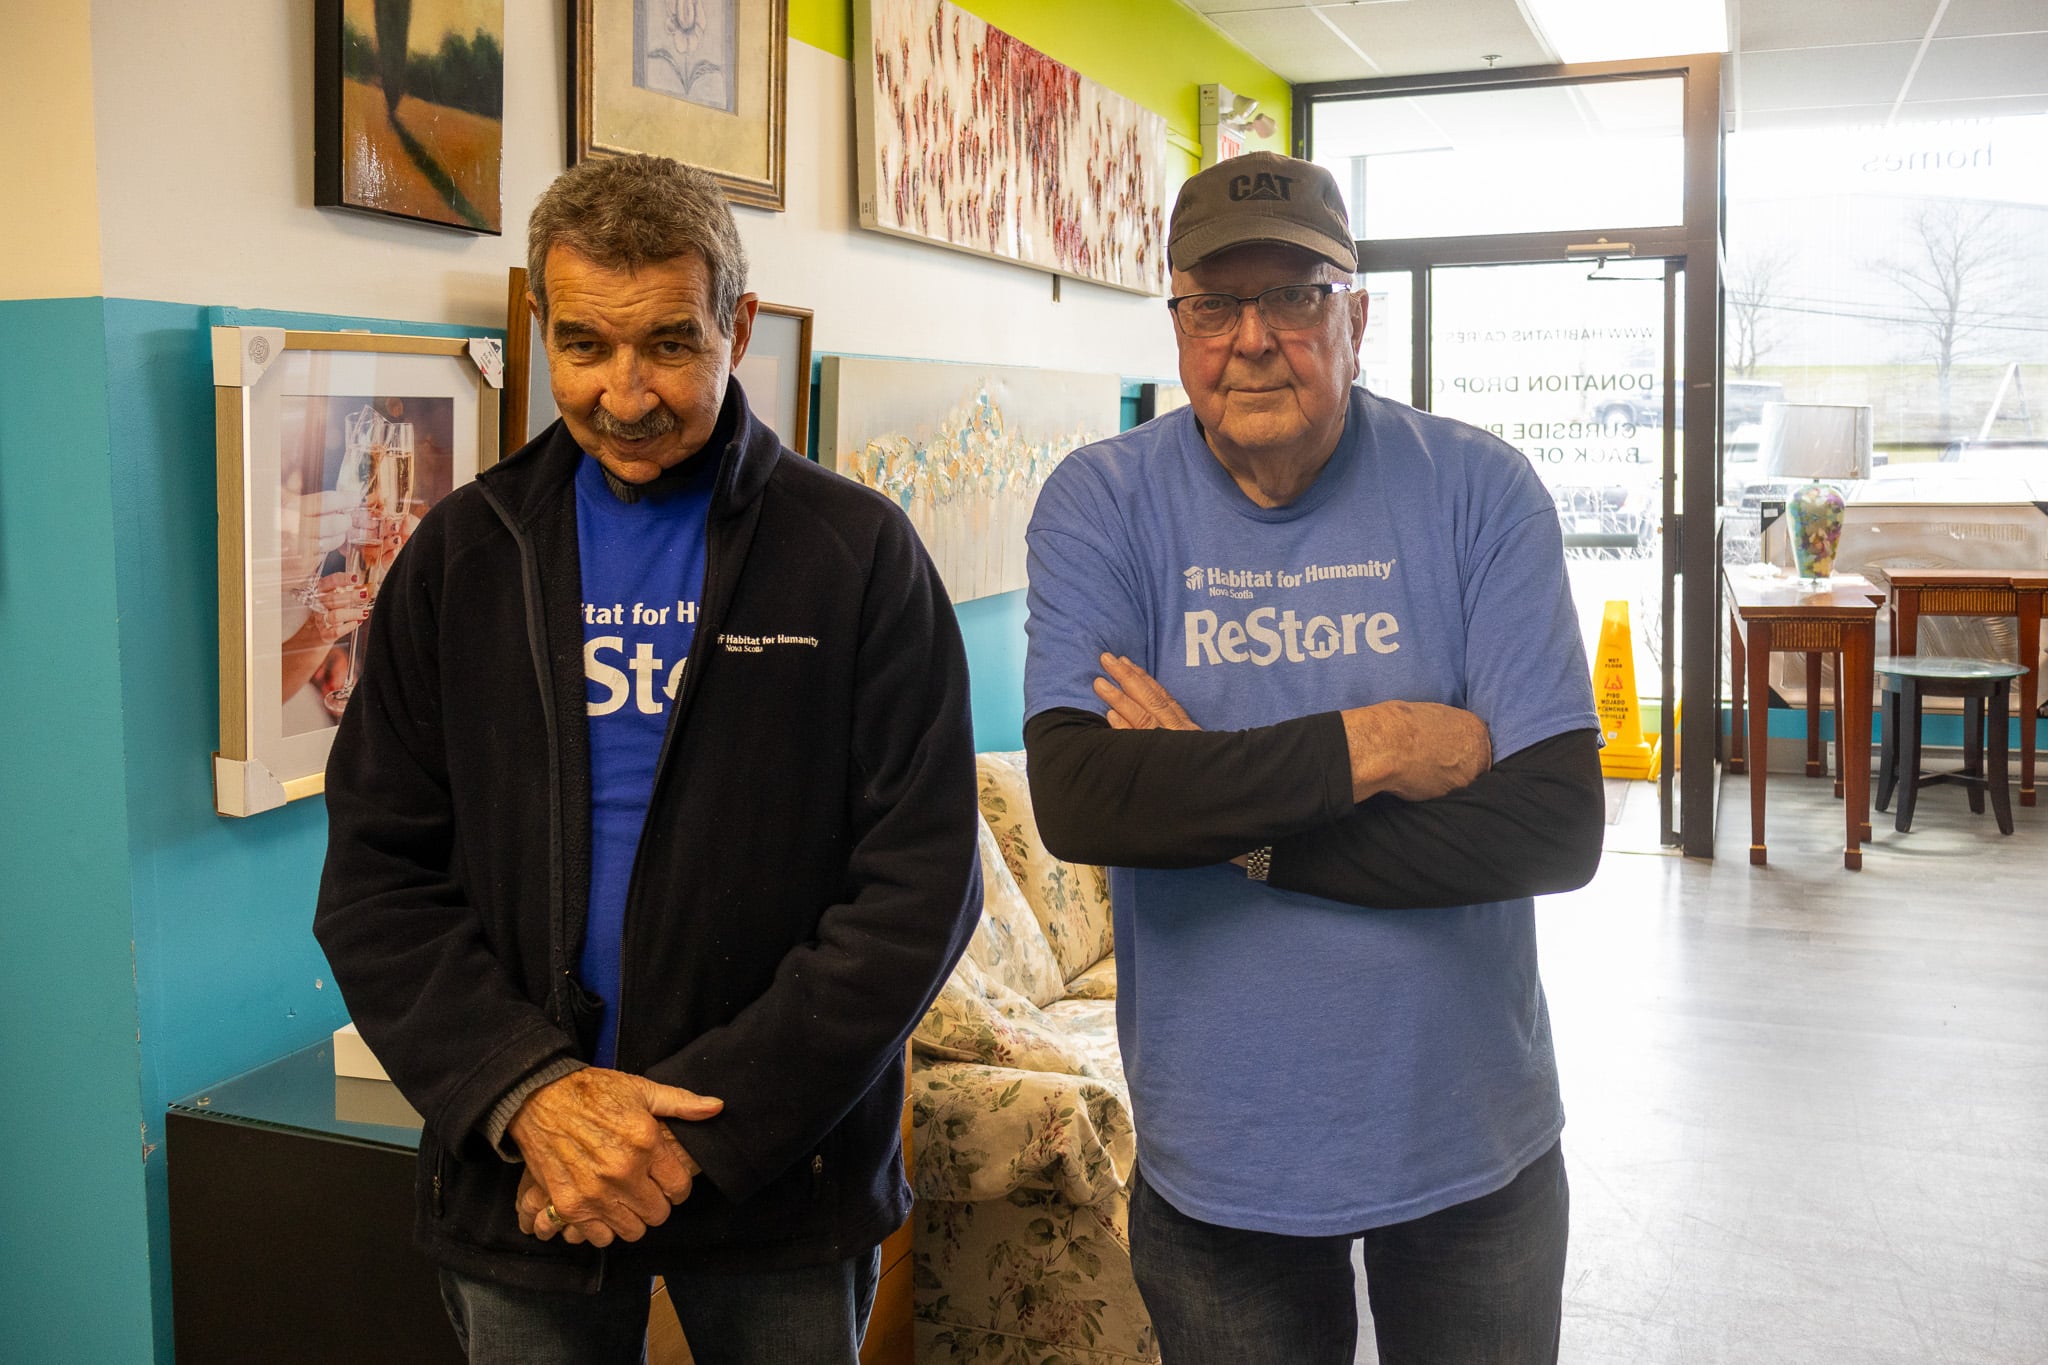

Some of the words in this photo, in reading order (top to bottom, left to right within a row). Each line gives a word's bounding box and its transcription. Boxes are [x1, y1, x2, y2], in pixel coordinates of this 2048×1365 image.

[1229, 173, 1294, 202] CAT
[1207, 567, 1273, 588] Habitat
[1276, 571, 1303, 588] for
[1305, 559, 1392, 581] Humanity
[1209, 587, 1229, 598] Nova
[1229, 588, 1254, 600] Scotia
[632, 602, 670, 626] for
[726, 634, 760, 645] Habitat
[762, 635, 776, 645] for
[777, 633, 819, 648] Humanity
[1184, 607, 1400, 667] ReStore
